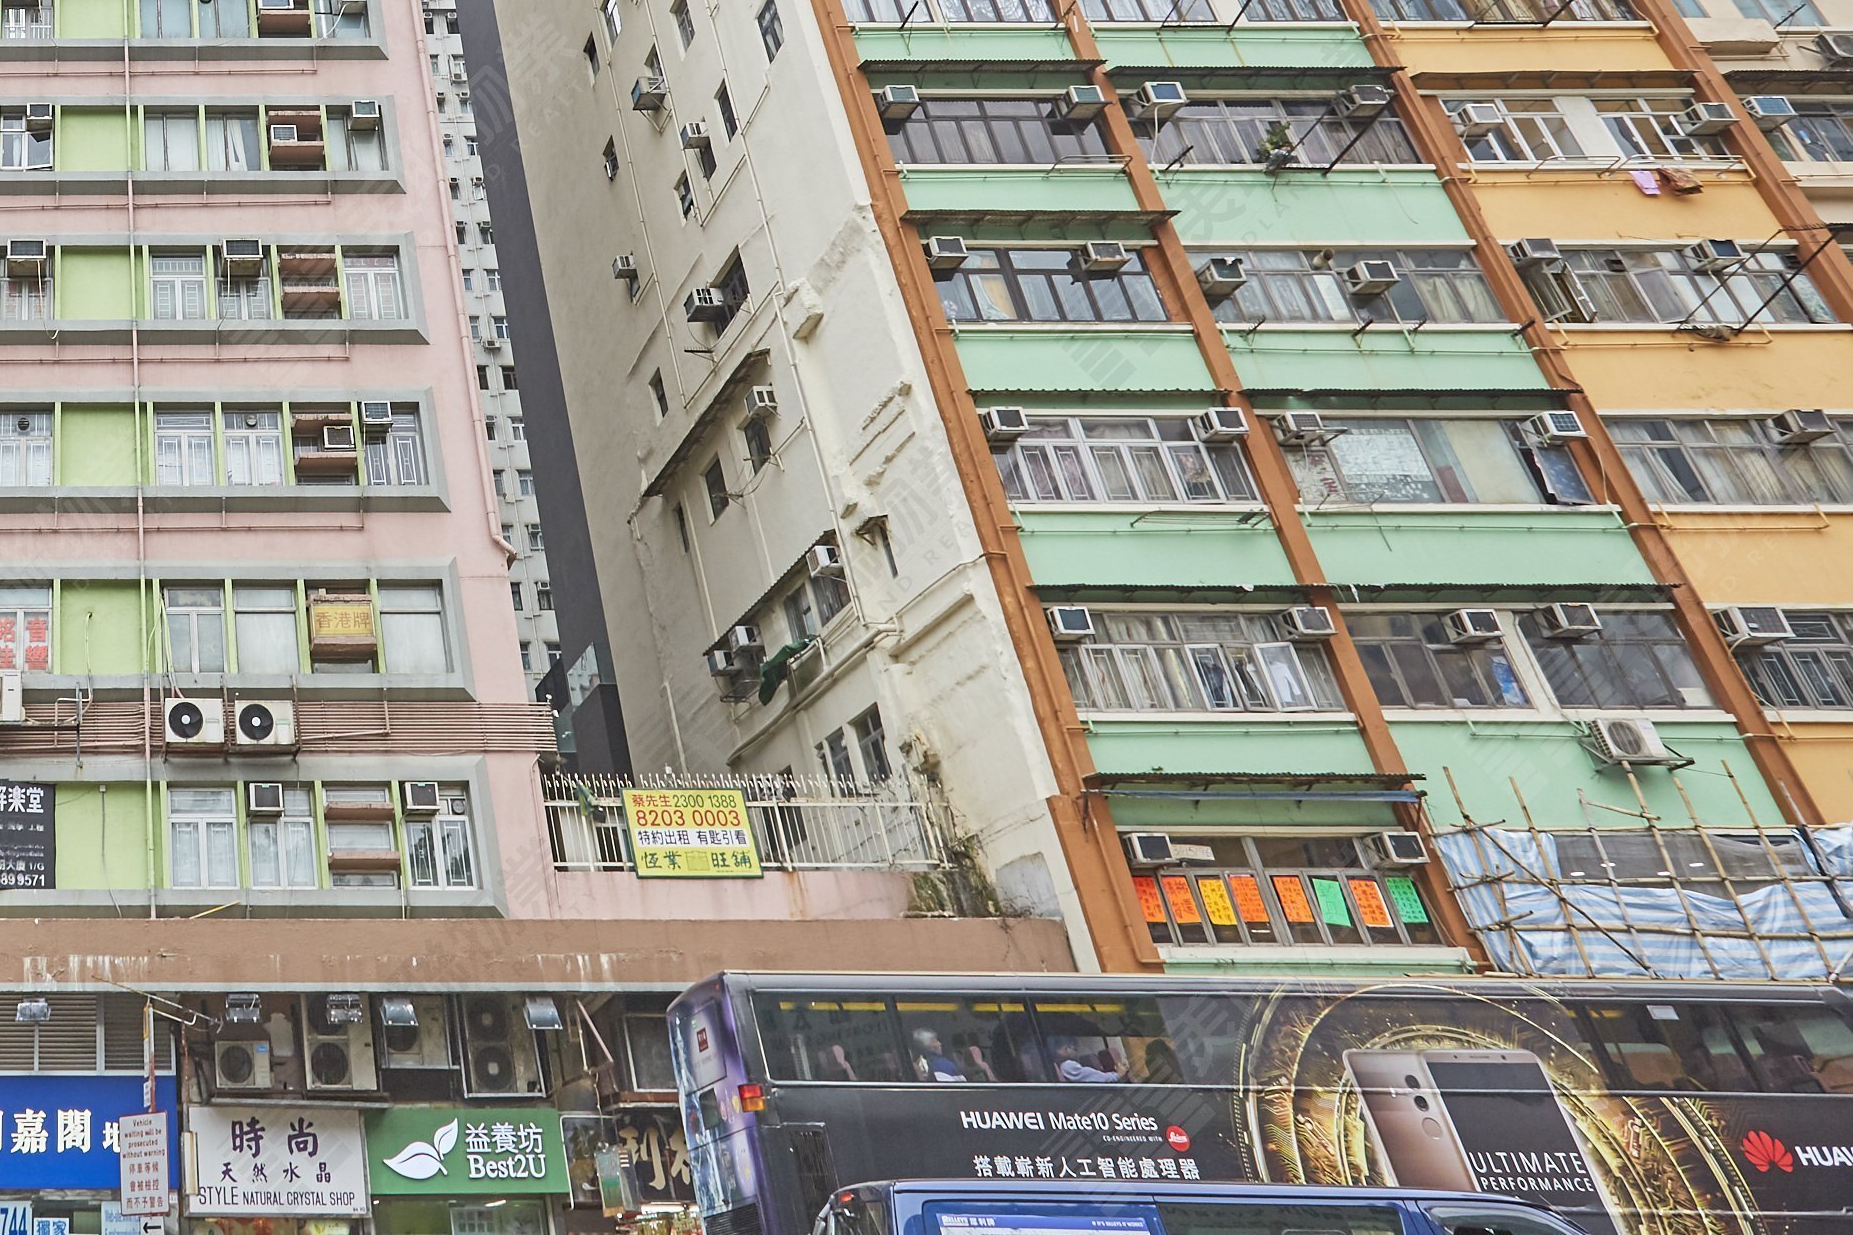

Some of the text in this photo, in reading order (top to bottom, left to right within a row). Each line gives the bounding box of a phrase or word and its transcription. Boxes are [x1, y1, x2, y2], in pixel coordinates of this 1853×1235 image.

[632, 794, 737, 808] 蔡先生 2300 1388
[636, 810, 741, 827] 8203 0003
[638, 830, 690, 845] 特約出租
[17, 873, 45, 887] 9571
[132, 1119, 153, 1127] Vehicle
[960, 1111, 1158, 1132] HUAWEI Mate10 Series
[124, 1130, 144, 1139] waiting
[231, 1116, 319, 1159] 時尚
[465, 1121, 544, 1154] 益養坊
[128, 1139, 159, 1149] prosecuted
[122, 1149, 165, 1159] without warning
[129, 1162, 160, 1175] 停車等候
[466, 1154, 547, 1180] Best2U
[973, 1155, 1201, 1180] 搭載嶄新人工智能處理器
[1467, 1150, 1588, 1175] ULTIMATE
[220, 1162, 332, 1184] 天然水晶
[130, 1179, 160, 1192] 會被檢控
[1480, 1176, 1594, 1193] PERFORMANCE
[126, 1196, 164, 1209] 而不予警告
[199, 1186, 356, 1207] STYLE NATURAL CRYSTAL SHOP
